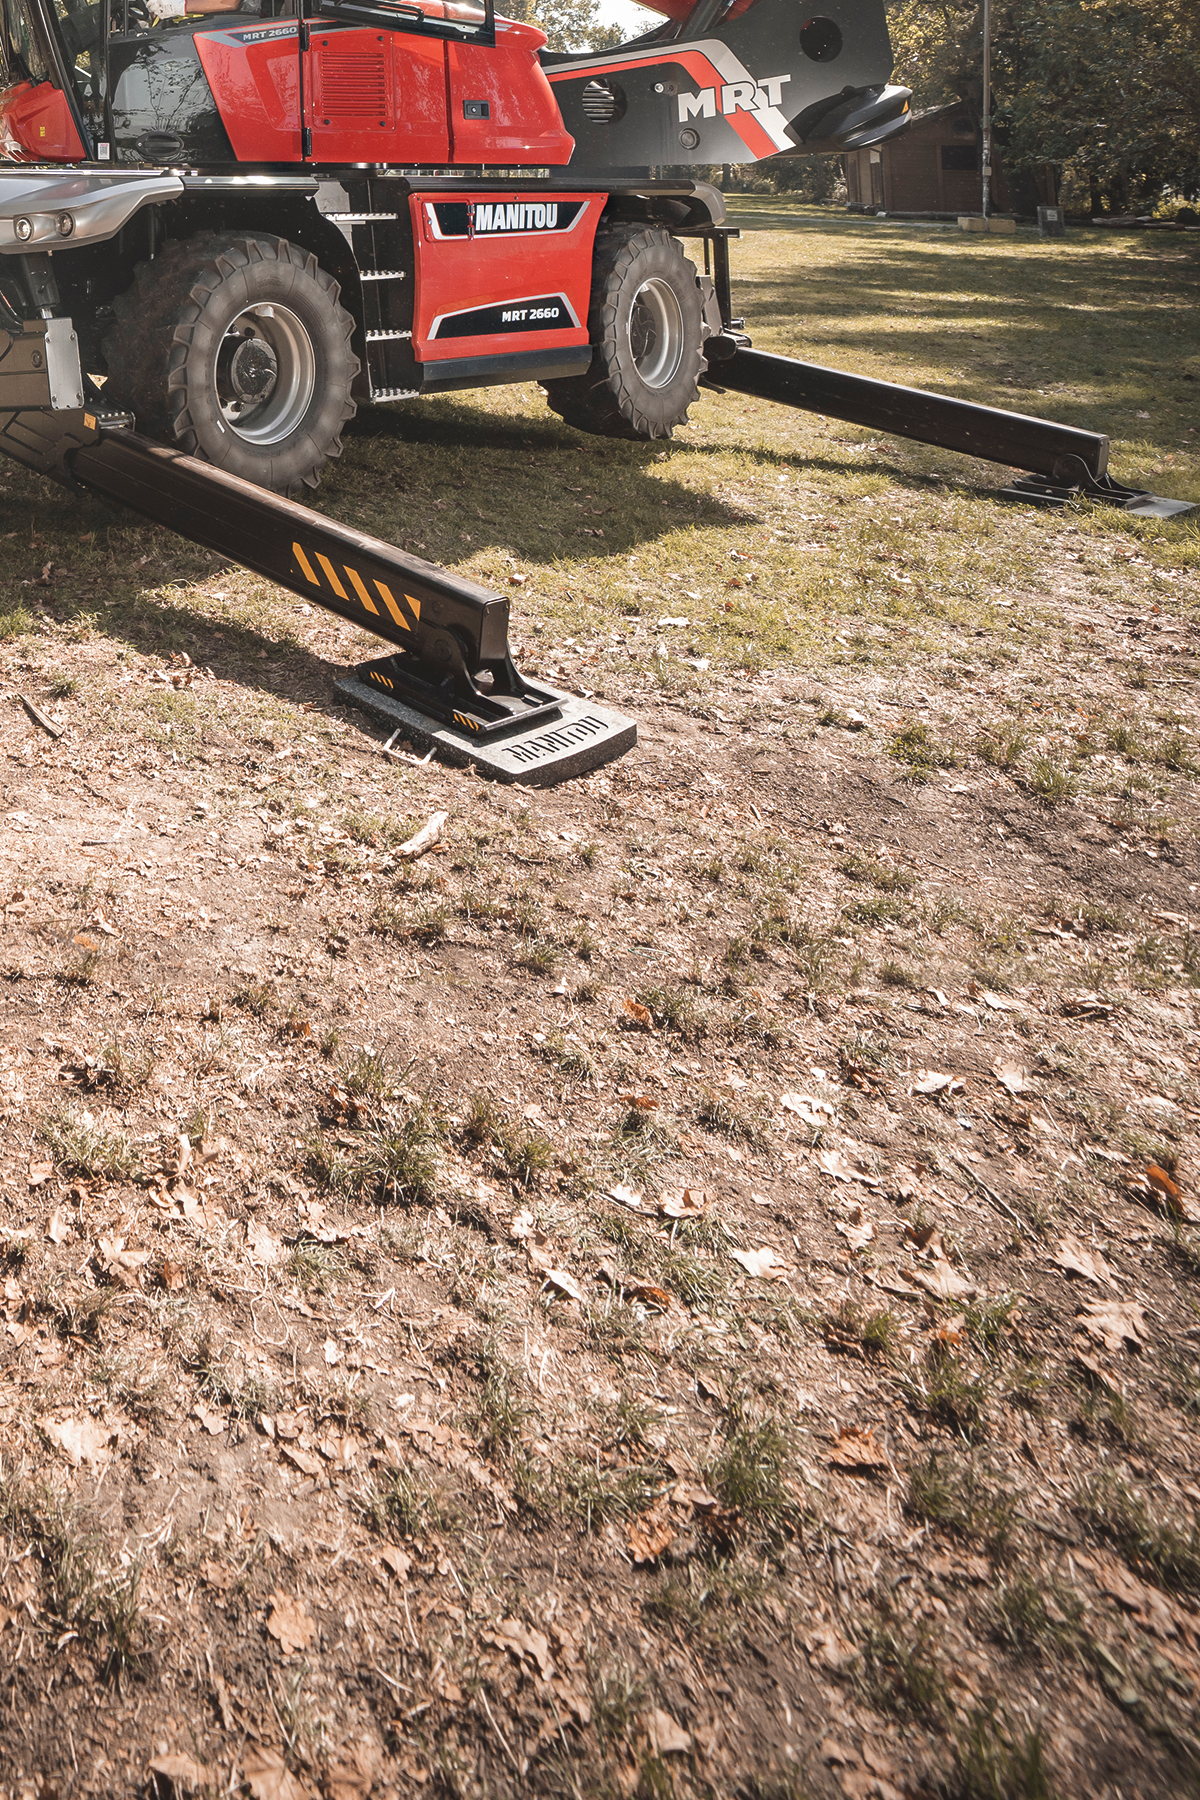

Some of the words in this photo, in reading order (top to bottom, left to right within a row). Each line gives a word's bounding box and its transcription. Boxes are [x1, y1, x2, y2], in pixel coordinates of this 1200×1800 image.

[243, 31, 267, 41] MRT
[268, 26, 298, 37] 2660
[677, 73, 791, 123] MRT
[475, 203, 558, 231] MANITOU
[501, 309, 528, 323] MRT
[528, 307, 560, 320] 2660
[501, 715, 609, 763] MANITOU
